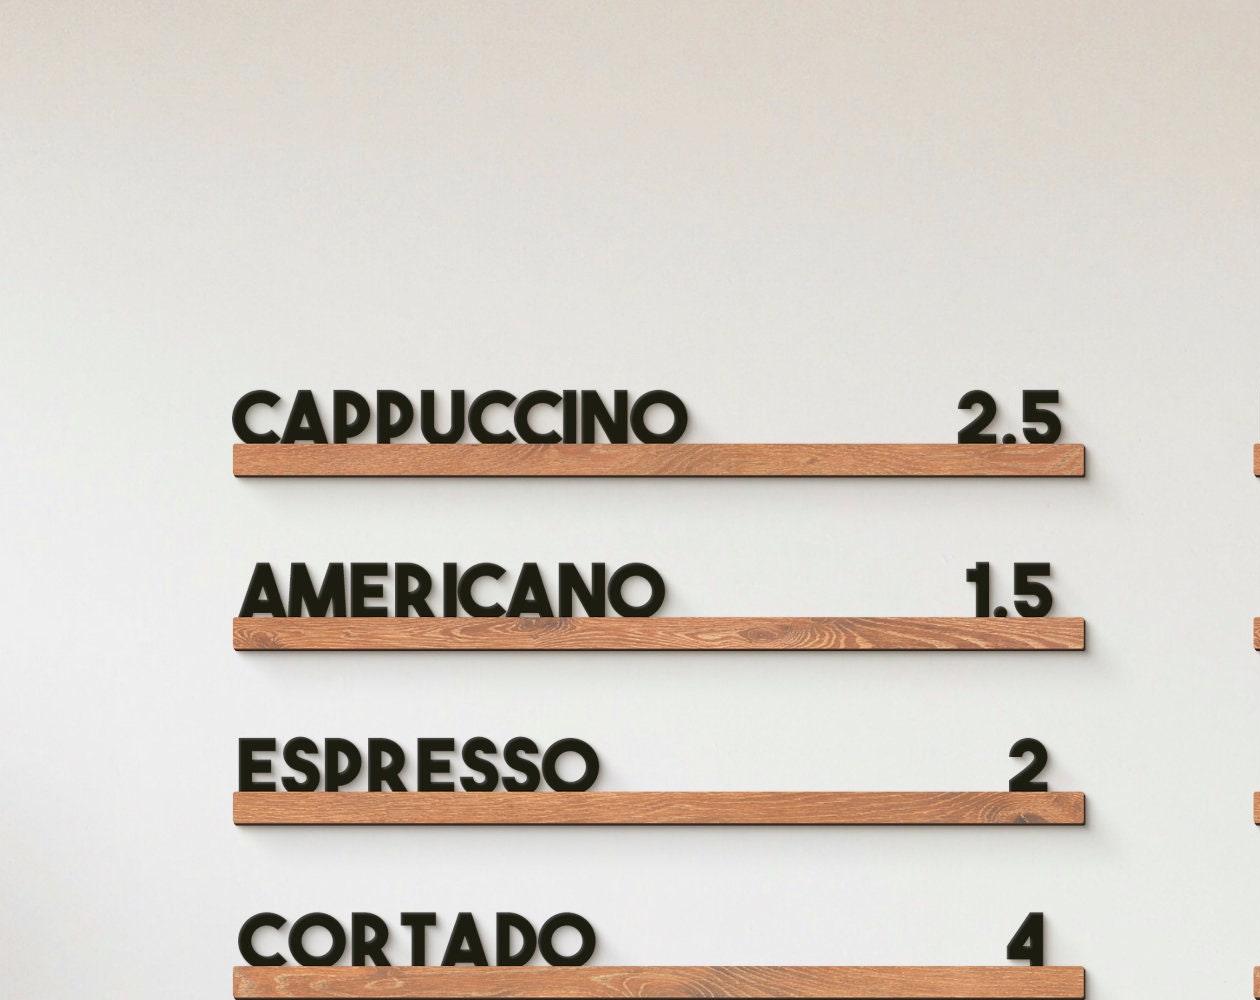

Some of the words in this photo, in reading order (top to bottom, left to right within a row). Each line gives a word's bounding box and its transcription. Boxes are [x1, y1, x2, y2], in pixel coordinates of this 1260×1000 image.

[232, 389, 689, 444] CAPPUCCINO
[957, 389, 1062, 444] 2.5
[239, 562, 666, 617] AMERICANO
[966, 562, 1054, 617] 1.5
[238, 736, 600, 792] ESPRESSO
[1008, 737, 1049, 792] 2
[237, 912, 597, 966] CORTADO
[1006, 912, 1044, 966] 4
